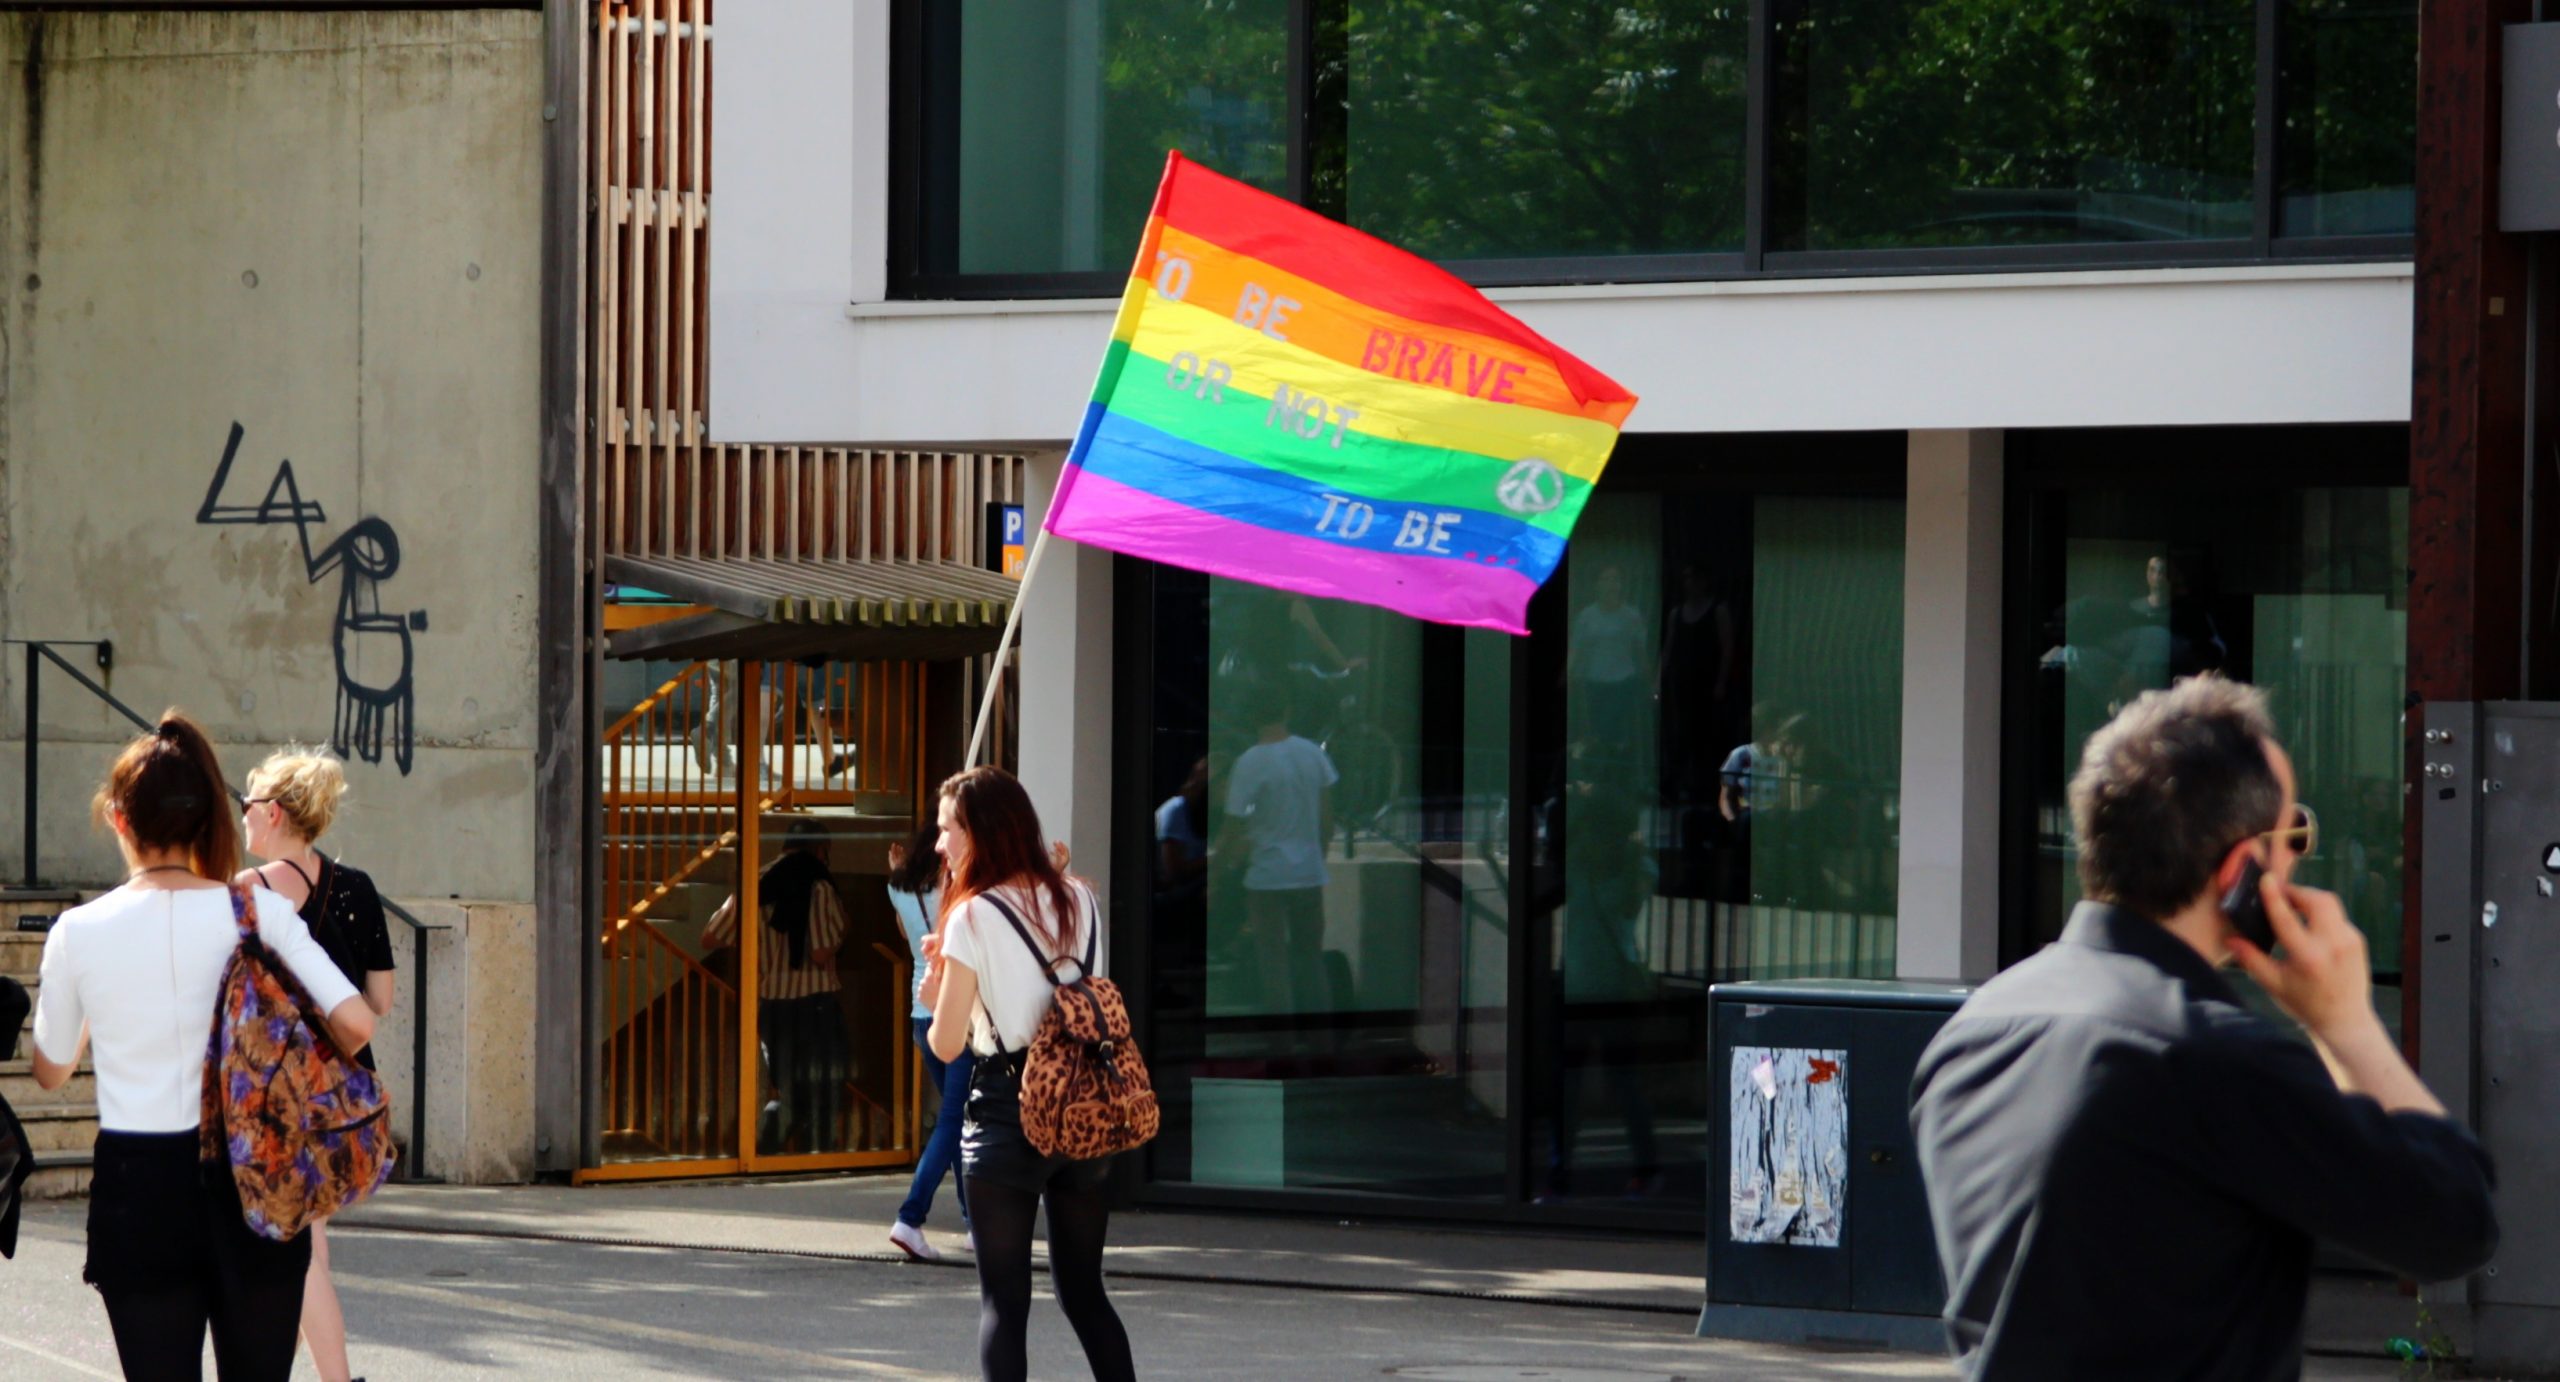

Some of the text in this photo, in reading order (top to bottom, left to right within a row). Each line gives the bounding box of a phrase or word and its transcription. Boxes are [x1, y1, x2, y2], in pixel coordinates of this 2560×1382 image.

[1157, 251, 1527, 404] O BE BRAVE
[1165, 351, 1360, 449] OR NOT
[1006, 511, 1021, 541] P
[1315, 493, 1374, 539] TO
